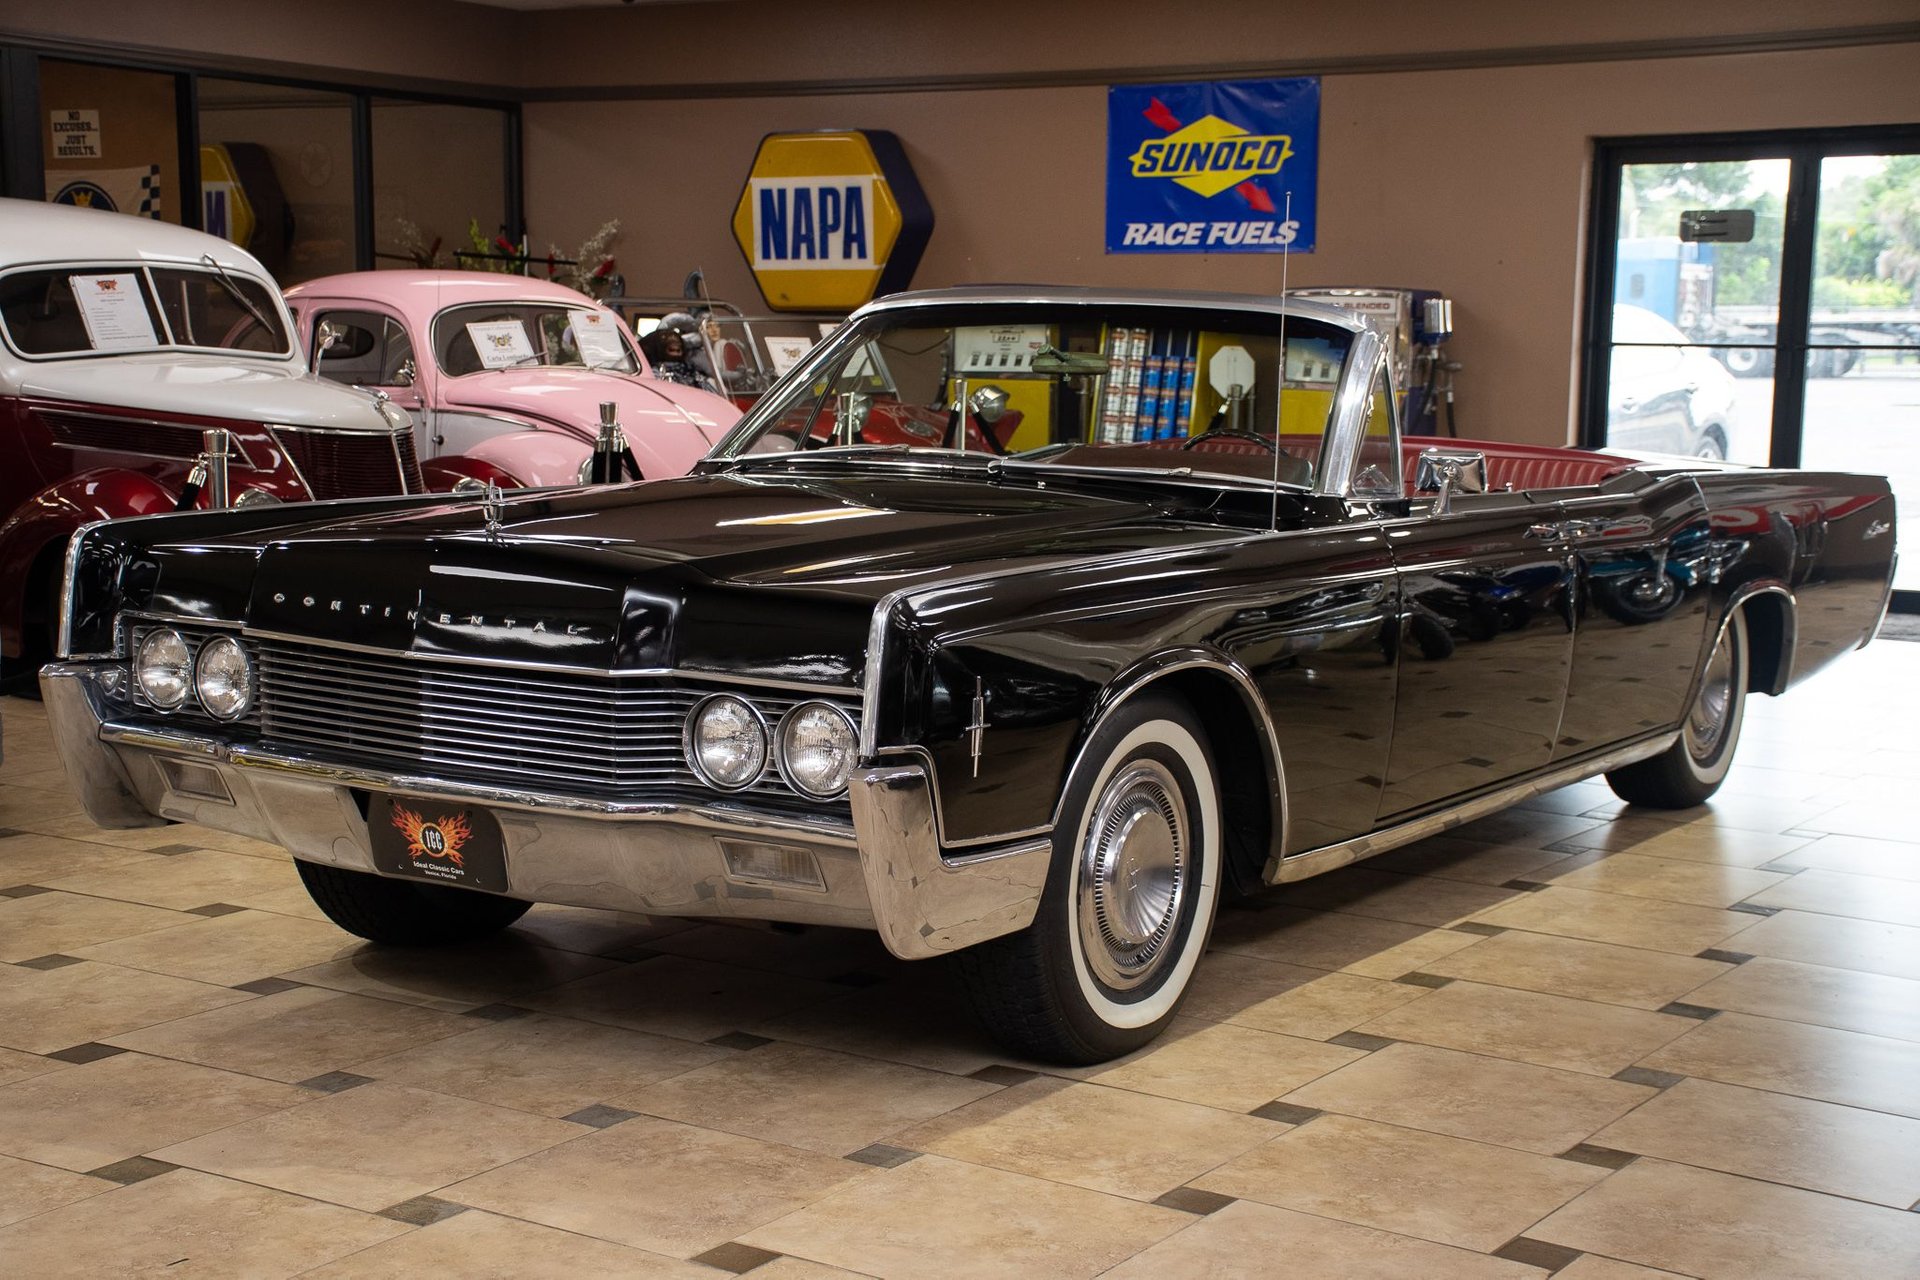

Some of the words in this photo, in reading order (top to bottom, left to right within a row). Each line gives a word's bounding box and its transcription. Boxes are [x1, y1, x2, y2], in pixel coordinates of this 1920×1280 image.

[68, 111, 81, 121] NO
[65, 135, 86, 145] JUST
[57, 146, 97, 156] RESULTS.
[1137, 140, 1285, 173] SUNOCO
[760, 186, 867, 260] NAPA
[1122, 222, 1206, 246] RACE
[1206, 220, 1300, 246] FUELS
[273, 592, 579, 635] CONTINENTAL
[425, 830, 442, 850] ICC
[428, 863, 450, 872] Classic
[450, 867, 465, 875] Cars
